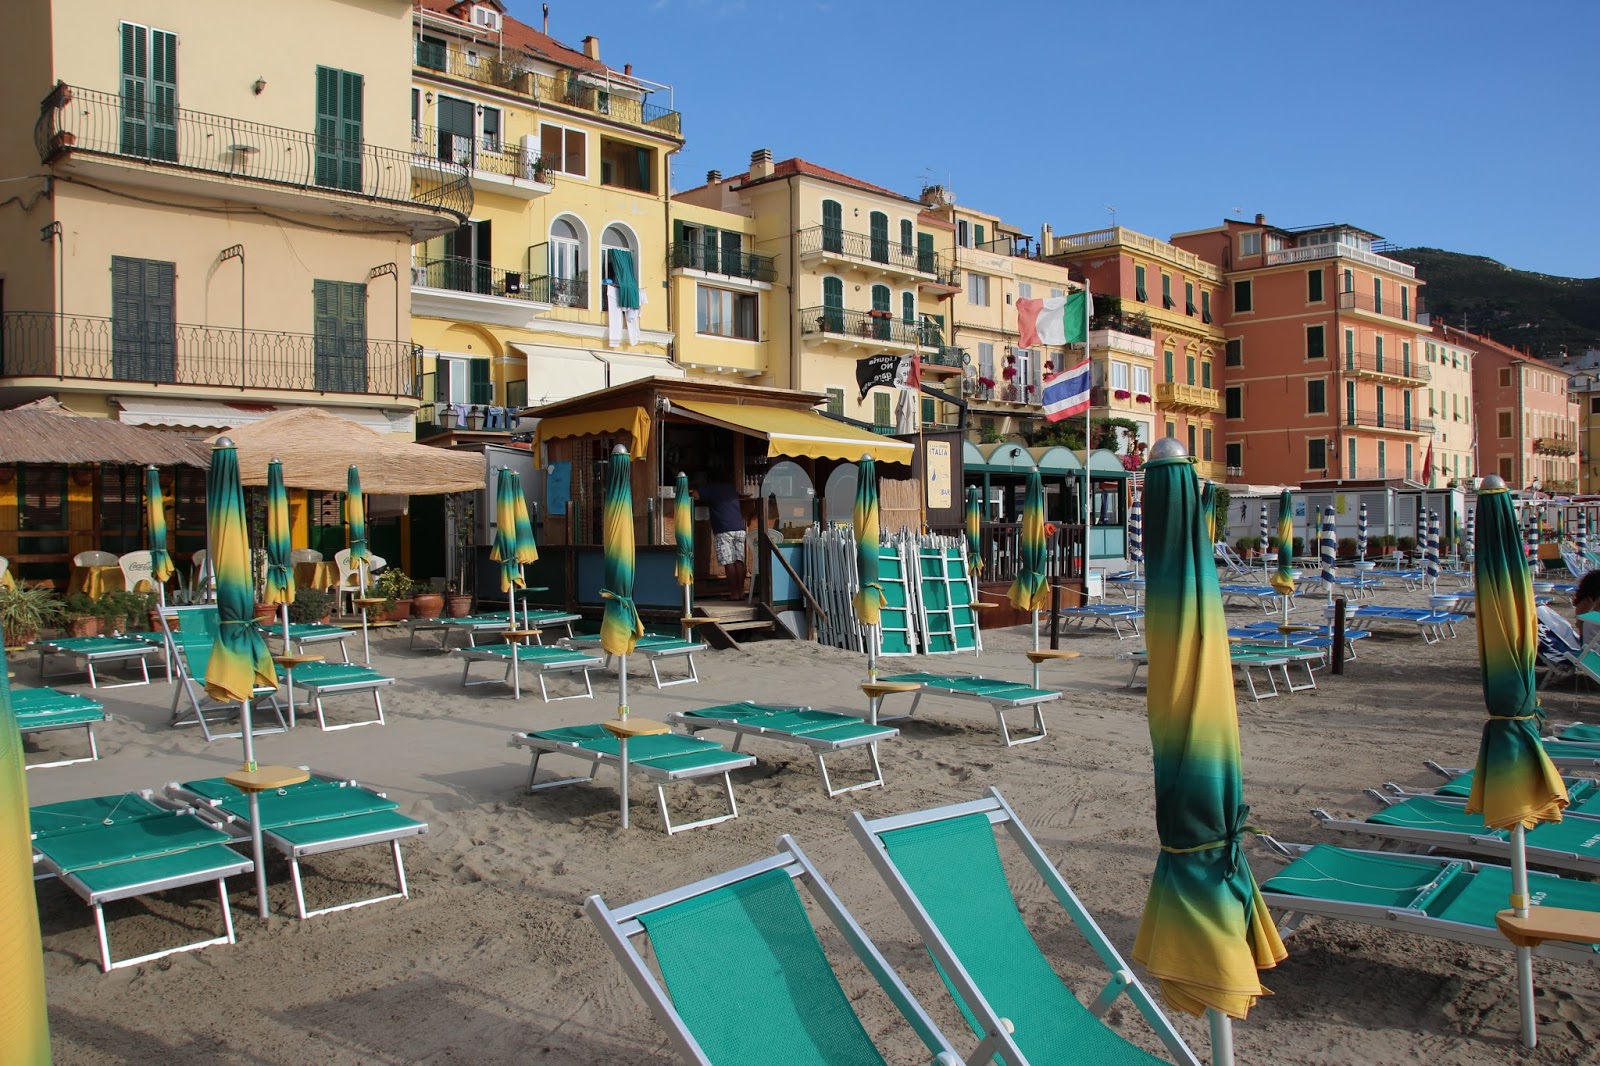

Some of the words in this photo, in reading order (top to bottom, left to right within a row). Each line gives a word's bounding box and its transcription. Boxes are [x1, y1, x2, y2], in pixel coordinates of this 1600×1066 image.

[929, 447, 948, 456] ITALIA
[941, 488, 951, 496] BAR
[129, 561, 153, 571] Coca-Co
